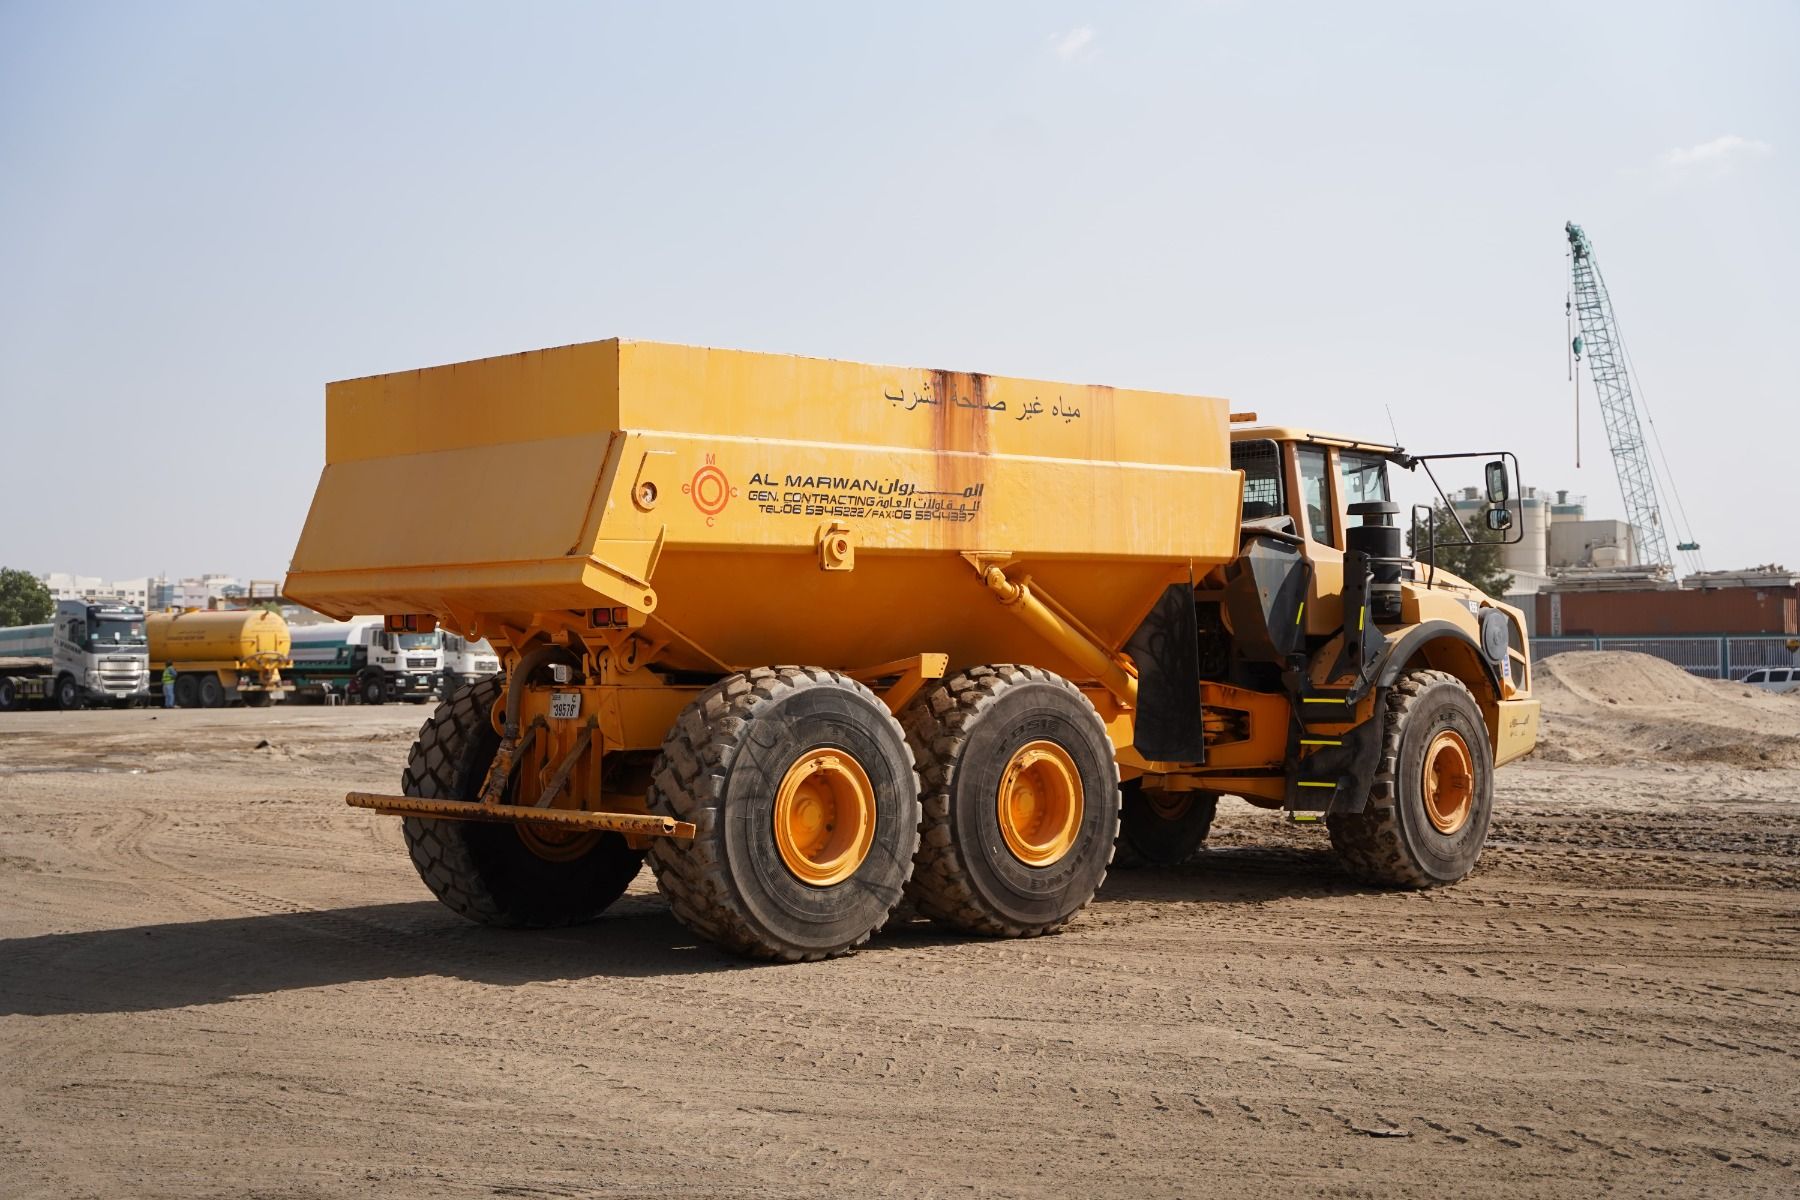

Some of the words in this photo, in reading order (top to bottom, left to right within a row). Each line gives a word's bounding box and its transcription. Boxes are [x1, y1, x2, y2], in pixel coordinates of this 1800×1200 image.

[1015, 396, 1044, 421] غير
[1052, 395, 1081, 424] مياه
[705, 453, 716, 465] M
[682, 484, 691, 494] G
[749, 473, 779, 486] AL
[784, 474, 878, 492] MARWAN
[730, 487, 738, 498] C
[748, 491, 779, 502] GEN.
[783, 492, 875, 507] CONTRACTING
[876, 496, 912, 510] العامة
[706, 516, 715, 528] C
